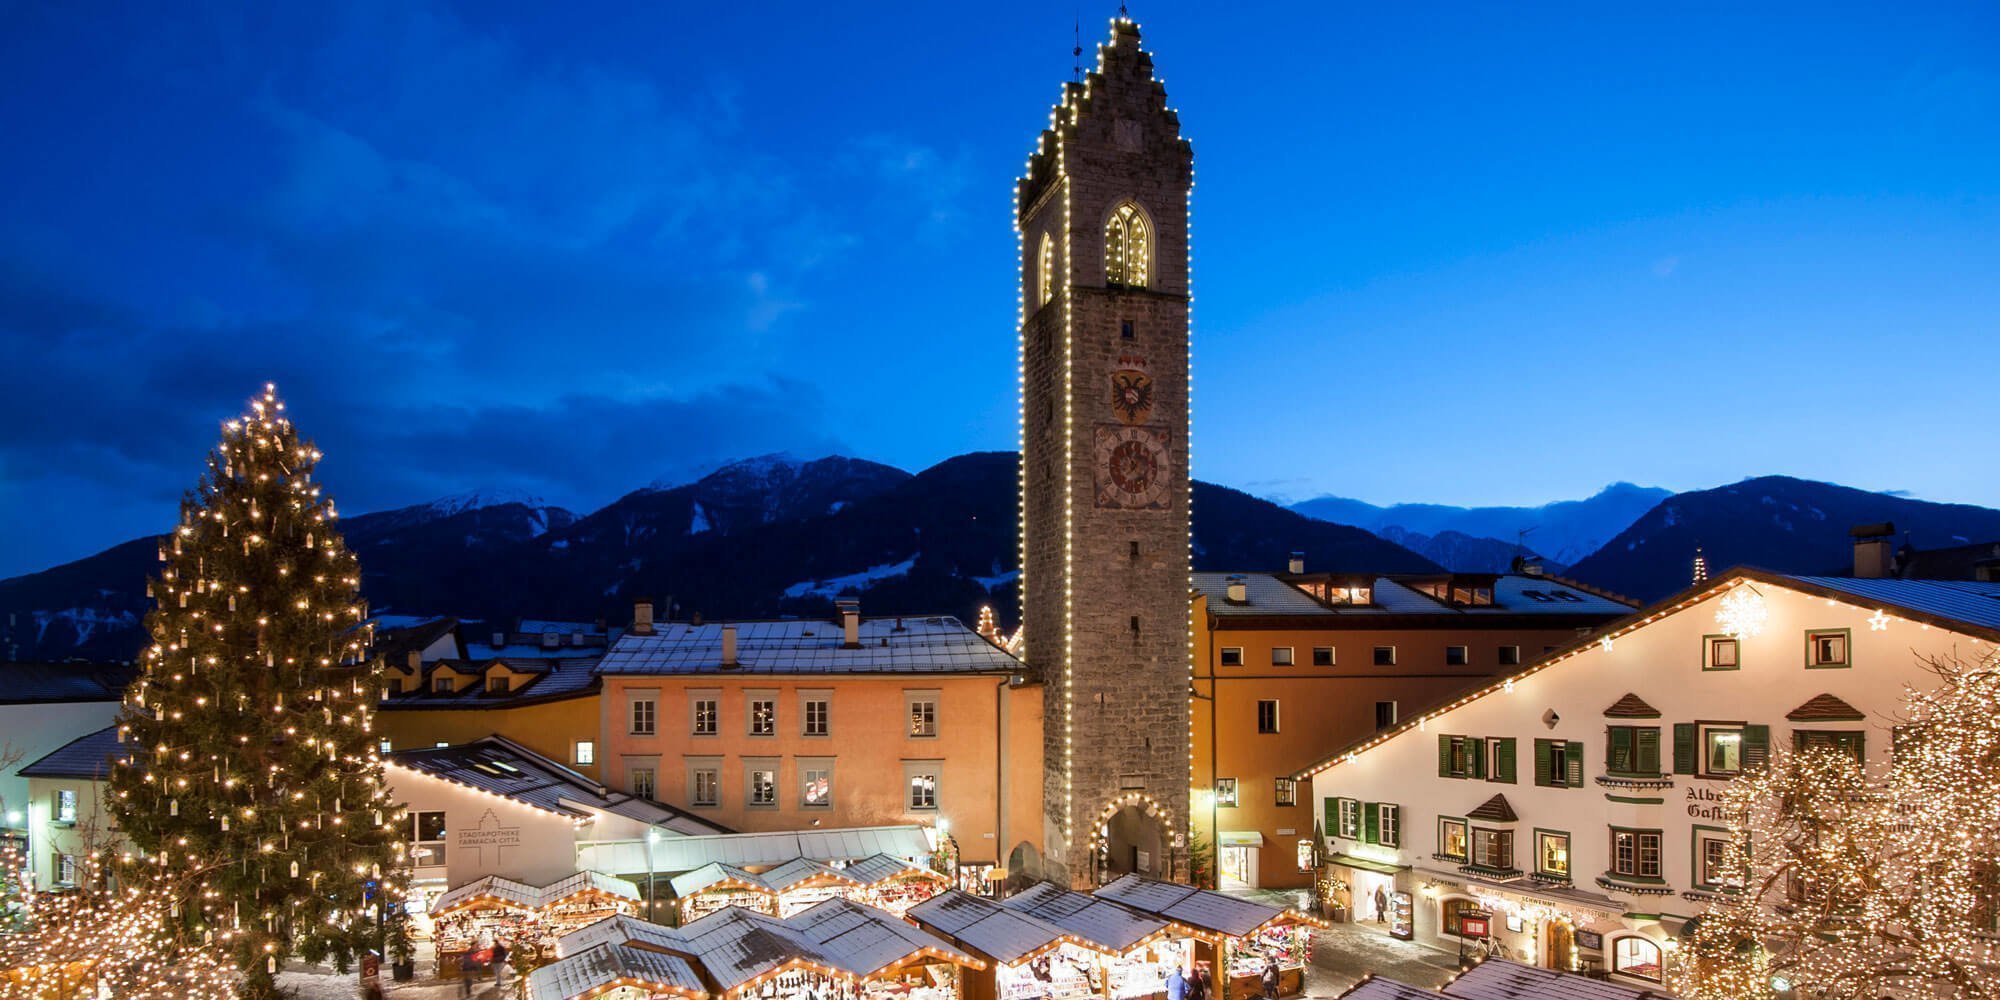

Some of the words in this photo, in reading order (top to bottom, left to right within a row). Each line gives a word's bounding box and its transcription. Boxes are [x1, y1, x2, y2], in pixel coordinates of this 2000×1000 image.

[1686, 787, 1729, 802] Albe
[458, 830, 520, 838] STADTAPOTHEKE
[1521, 896, 1556, 907] SCHWEMME
